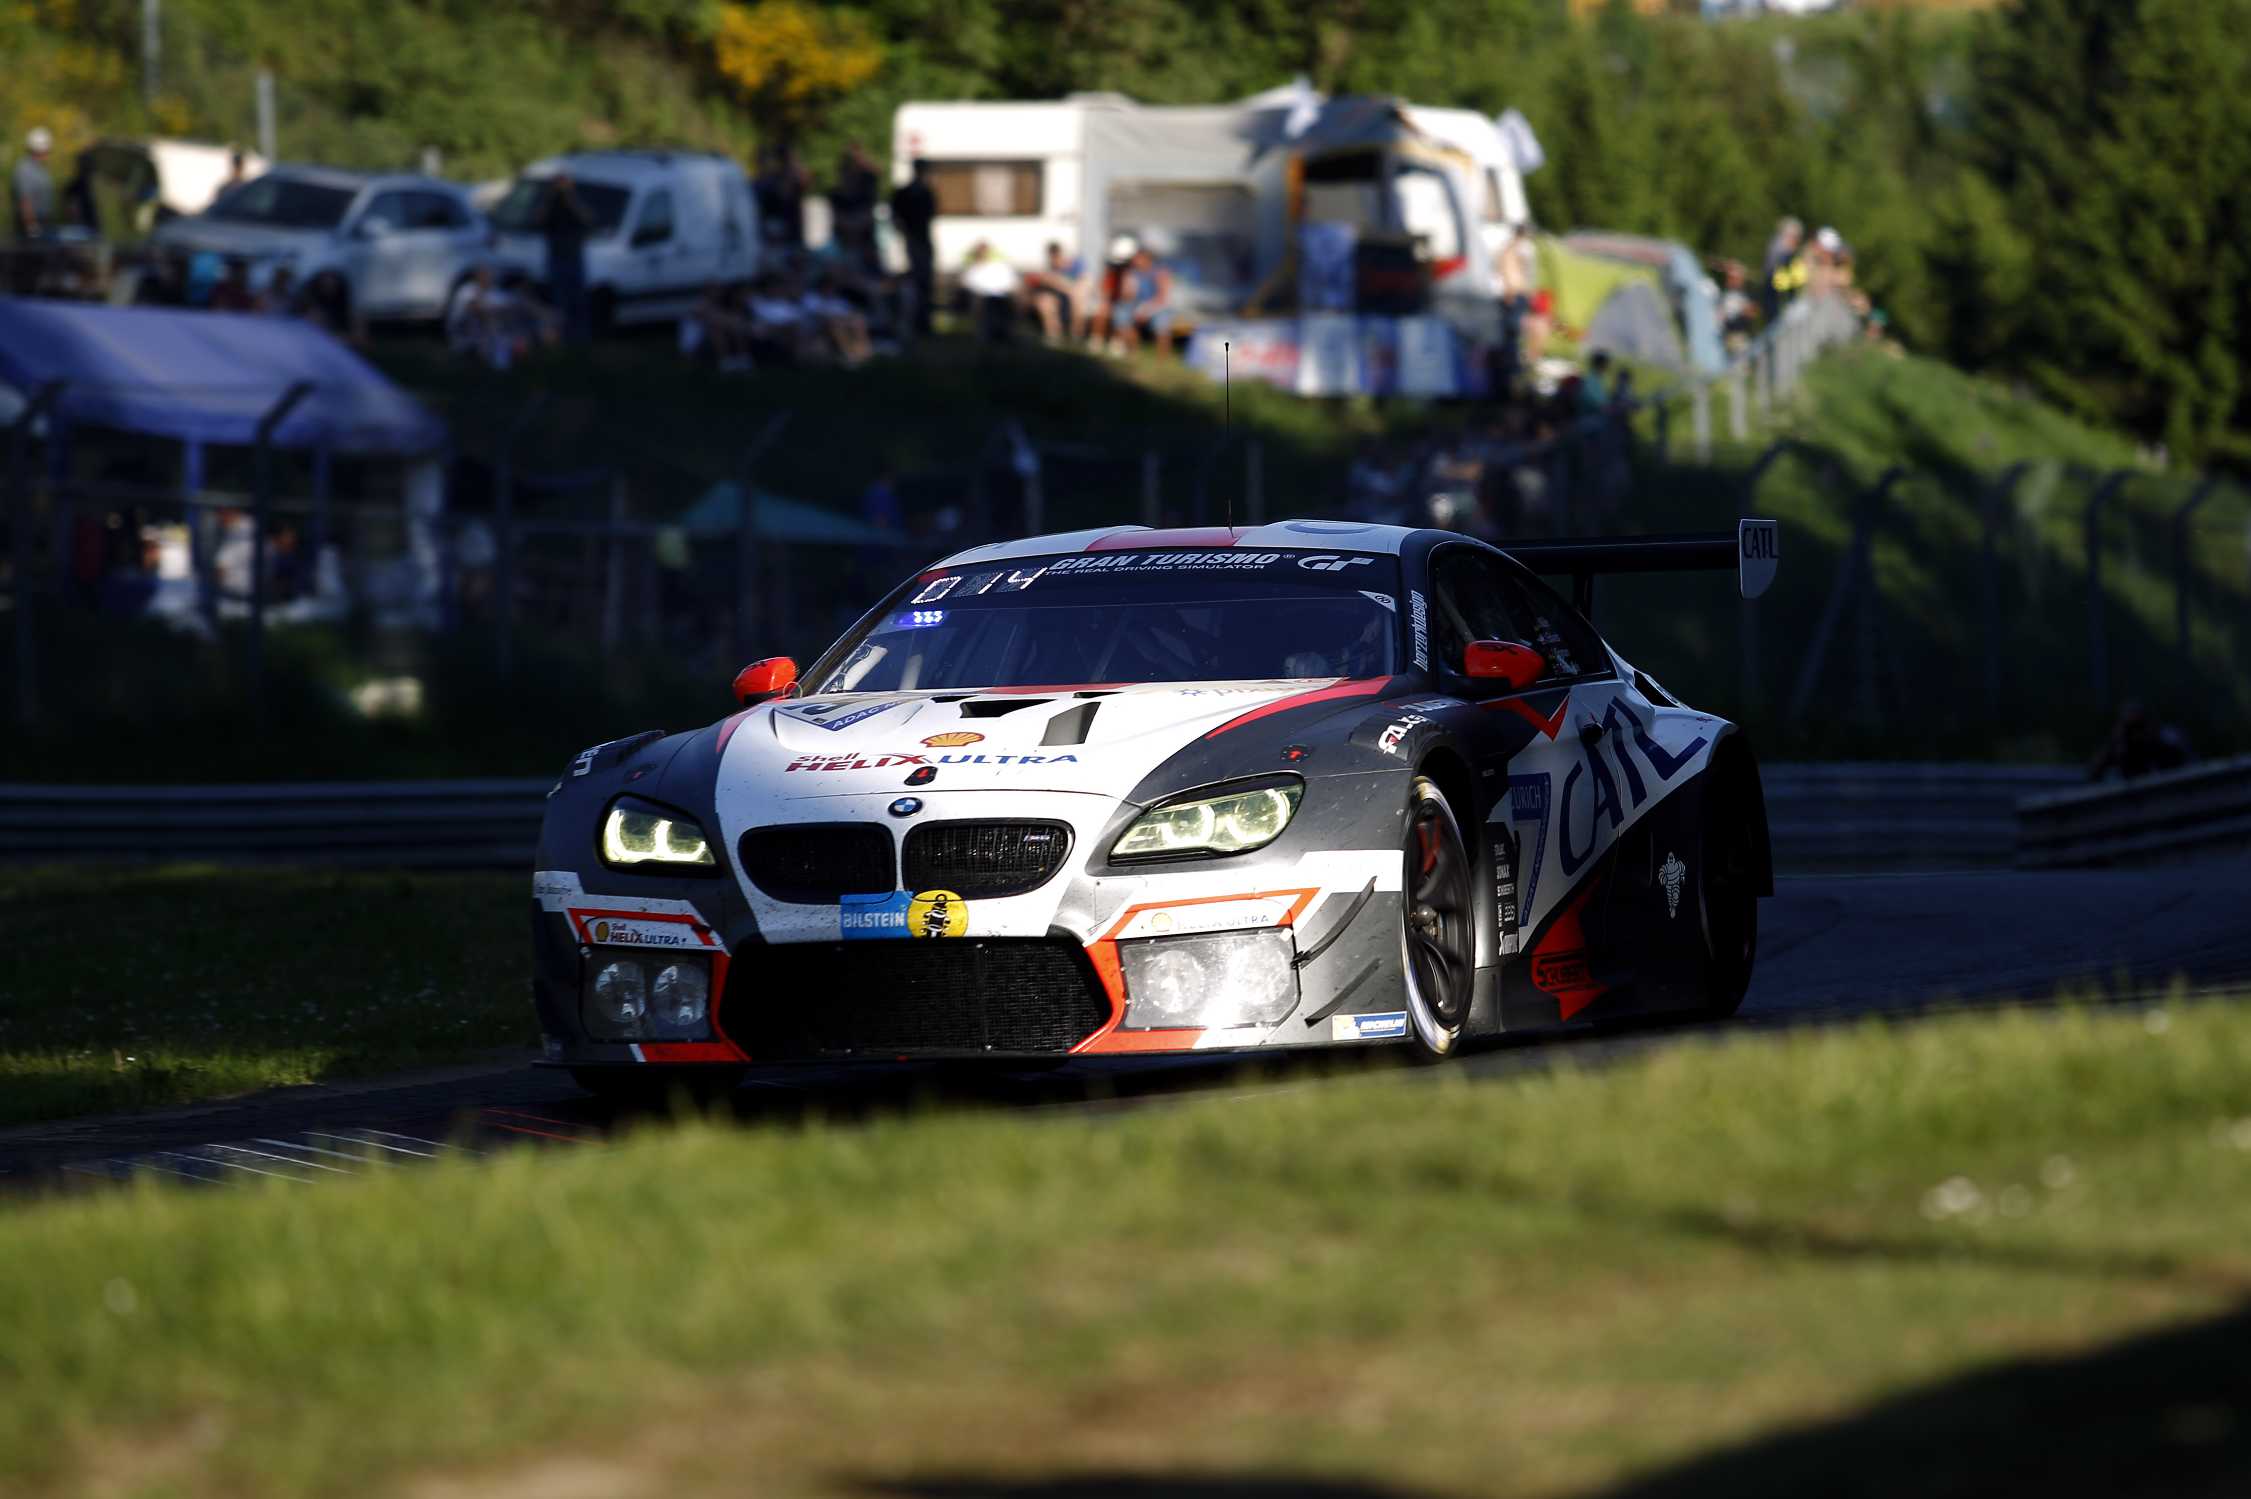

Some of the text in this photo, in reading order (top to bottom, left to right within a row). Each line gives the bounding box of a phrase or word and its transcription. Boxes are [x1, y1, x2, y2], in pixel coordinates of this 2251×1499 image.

[1744, 527, 1779, 559] CATL
[1049, 553, 1281, 570] GRAN TURISMO
[832, 706, 879, 729] ADAC
[785, 754, 1078, 773] HELIX ULTRA
[797, 753, 860, 762] Shell
[1559, 696, 1708, 877] CATL
[843, 911, 905, 929] BILSTEIN
[642, 934, 680, 945] ULTRA
